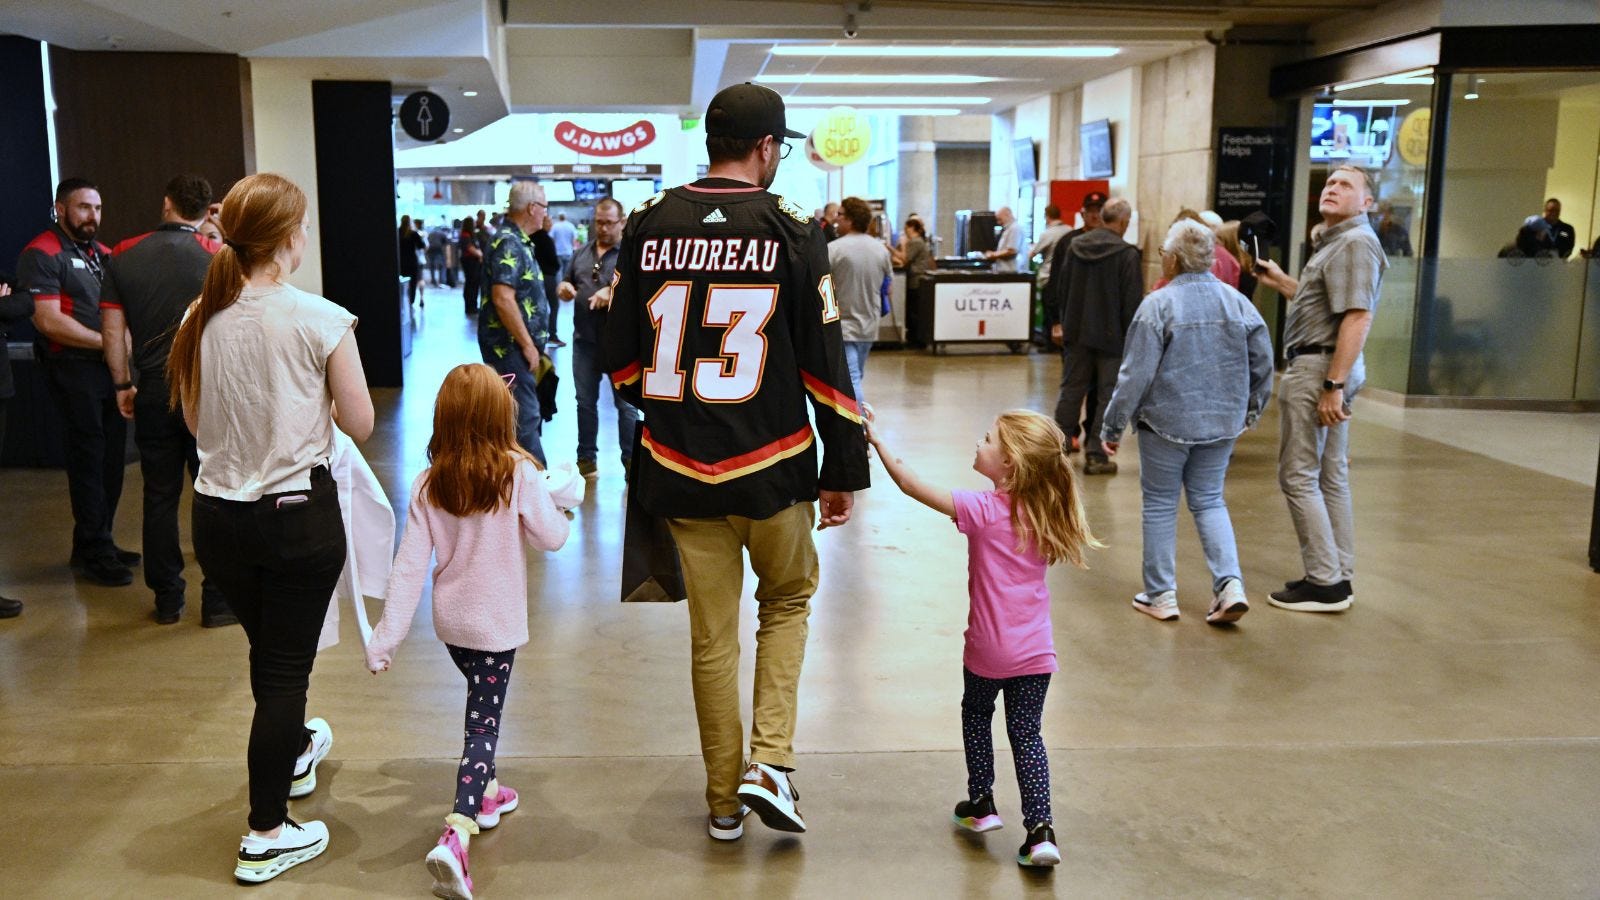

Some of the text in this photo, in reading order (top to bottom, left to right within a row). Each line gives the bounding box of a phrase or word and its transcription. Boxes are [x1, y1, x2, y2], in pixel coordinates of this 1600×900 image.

[562, 126, 647, 151] J.DAWGS
[825, 138, 860, 158] SHOP
[1222, 134, 1272, 145] Feedback
[1222, 146, 1251, 158] Helps
[640, 238, 779, 272] GAUDREAU
[818, 274, 840, 324] 1
[955, 298, 1013, 311] ULTRA
[642, 280, 780, 404] 13
